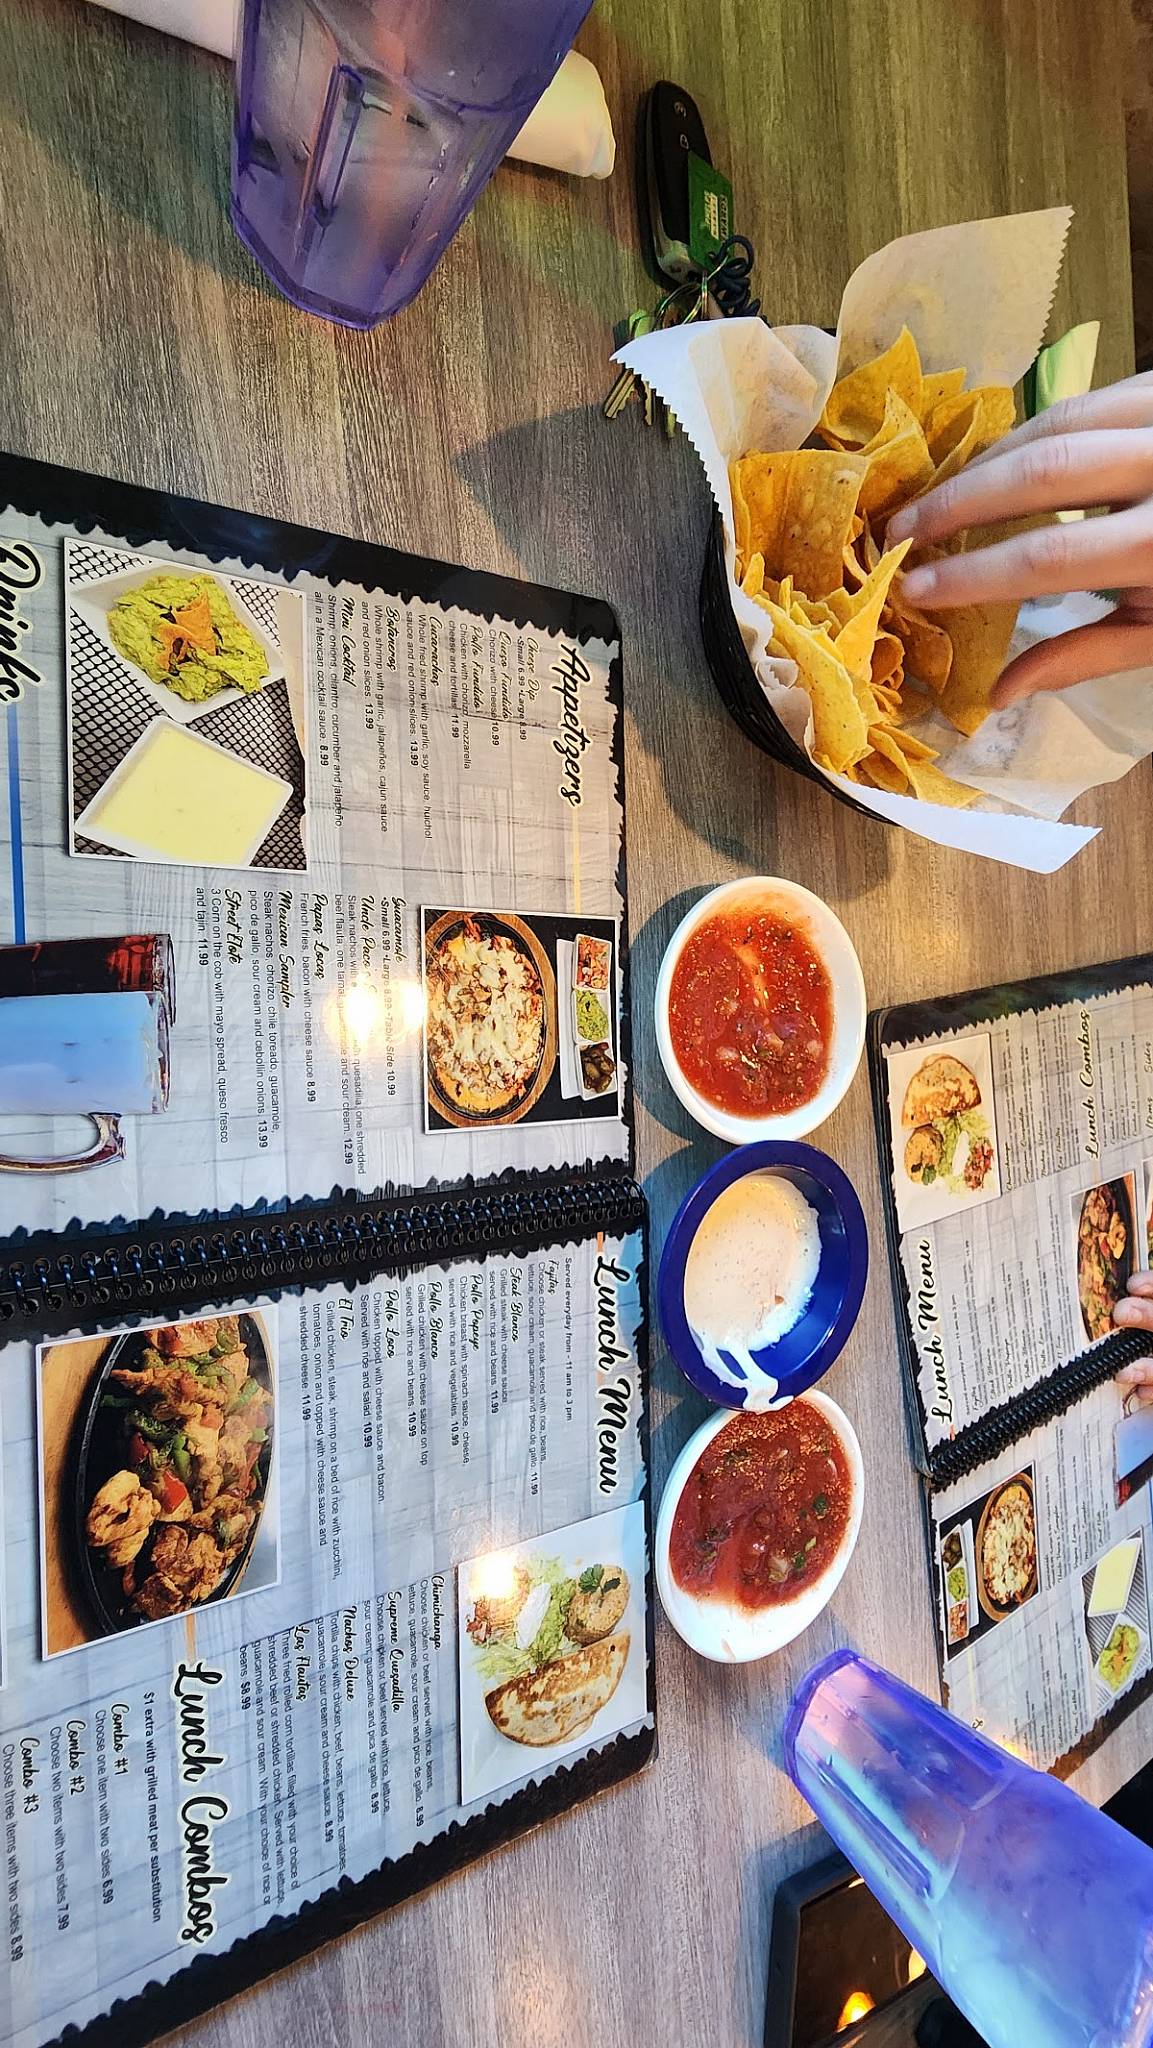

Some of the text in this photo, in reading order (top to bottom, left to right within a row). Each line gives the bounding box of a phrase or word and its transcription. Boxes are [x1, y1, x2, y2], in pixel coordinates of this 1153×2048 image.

[315, 591, 324, 603] all
[315, 605, 324, 615] in
[326, 595, 337, 632] Shrimp,
[374, 604, 384, 635] Whole
[316, 626, 326, 667] Mexican
[328, 634, 339, 670] onions,
[342, 598, 356, 687] Mini Cocktail
[373, 637, 385, 670] shrimp
[386, 606, 399, 672] Botaneros
[428, 617, 442, 687] Cucarachas
[362, 601, 374, 729] and red onion slices. 13.99
[376, 671, 385, 691] with
[471, 626, 483, 709] Pollo Fundido
[499, 632, 512, 720] Queso Fundido
[527, 638, 539, 702] Cheese Dip
[317, 669, 327, 707] cocktail
[329, 672, 340, 711] cilantro,
[375, 693, 386, 722] garlic,
[318, 709, 326, 742] sauce.
[332, 713, 341, 762] cucumber
[552, 644, 590, 807] Appetizers
[320, 744, 329, 766] 8.99
[333, 764, 342, 783] and
[378, 775, 388, 801] cajun
[196, 887, 206, 907] and
[212, 897, 222, 923] Corn
[248, 890, 259, 911] pico
[301, 893, 310, 927] French
[360, 896, 374, 932] Uncle
[213, 925, 221, 939] on
[225, 889, 243, 964] Street Elote
[251, 913, 260, 926] de
[312, 894, 329, 980] Papas Locas
[391, 897, 406, 963] Guacamole
[198, 937, 208, 966] 11.99
[214, 941, 223, 958] the
[249, 929, 261, 957] gallo,
[278, 891, 295, 1009] Mexican Sampler
[301, 929, 311, 953] fries,
[214, 960, 224, 979] cob
[252, 959, 260, 981] sour
[303, 955, 312, 986] bacon
[215, 981, 225, 1003] with
[253, 983, 261, 1015] cream
[304, 988, 313, 1008] with
[214, 1005, 224, 1034] mayo
[254, 1018, 264, 1037] and
[264, 891, 281, 1134] Steak nachos, chorizo, chile toreado, guacamole,
[304, 1010, 314, 1046] cheese
[215, 1036, 227, 1075] spread,
[216, 1077, 226, 1109] queso
[307, 1080, 316, 1102] 8.99
[1078, 1010, 1098, 1158] Lunch Combos
[219, 1111, 229, 1144] fresco
[258, 1119, 268, 1148] 13.99
[547, 1260, 559, 1294] Fajitas
[339, 1298, 353, 1340] El Trio
[361, 1294, 370, 1328] Served
[429, 1282, 442, 1359] Pollo Blanco
[470, 1274, 482, 1351] Pollo Popeye
[510, 1267, 522, 1342] Steak Blanco
[563, 1290, 573, 1330] everyday
[362, 1329, 370, 1349] with
[385, 1290, 399, 1358] Pollo Loco
[918, 1240, 953, 1423] Lunch Menu
[362, 1351, 370, 1369] rice
[566, 1360, 573, 1370] 11
[594, 1258, 630, 1494] Lunch Menu
[362, 1370, 371, 1389] and
[566, 1372, 572, 1386] am
[566, 1387, 574, 1398] to
[565, 1406, 572, 1422] pm
[364, 1421, 372, 1448] 10.99
[431, 1576, 444, 1650] Chimichanga
[294, 1626, 310, 1701] Las Flautas
[344, 1606, 357, 1701] Nachos Deluxe
[387, 1591, 404, 1713] Supreme Quesadilla
[112, 1704, 129, 1775] Combo #1
[67, 1720, 85, 1795] Combo #2
[20, 1738, 39, 1813] Combo #3
[96, 1709, 113, 1905] Choose one item with two sides 6.99
[144, 1692, 163, 1923] $1 extra with grilled meat per substitution
[174, 1662, 227, 1943] Lunch Combos
[50, 1726, 68, 1930] Choose two items with two sides 7.99
